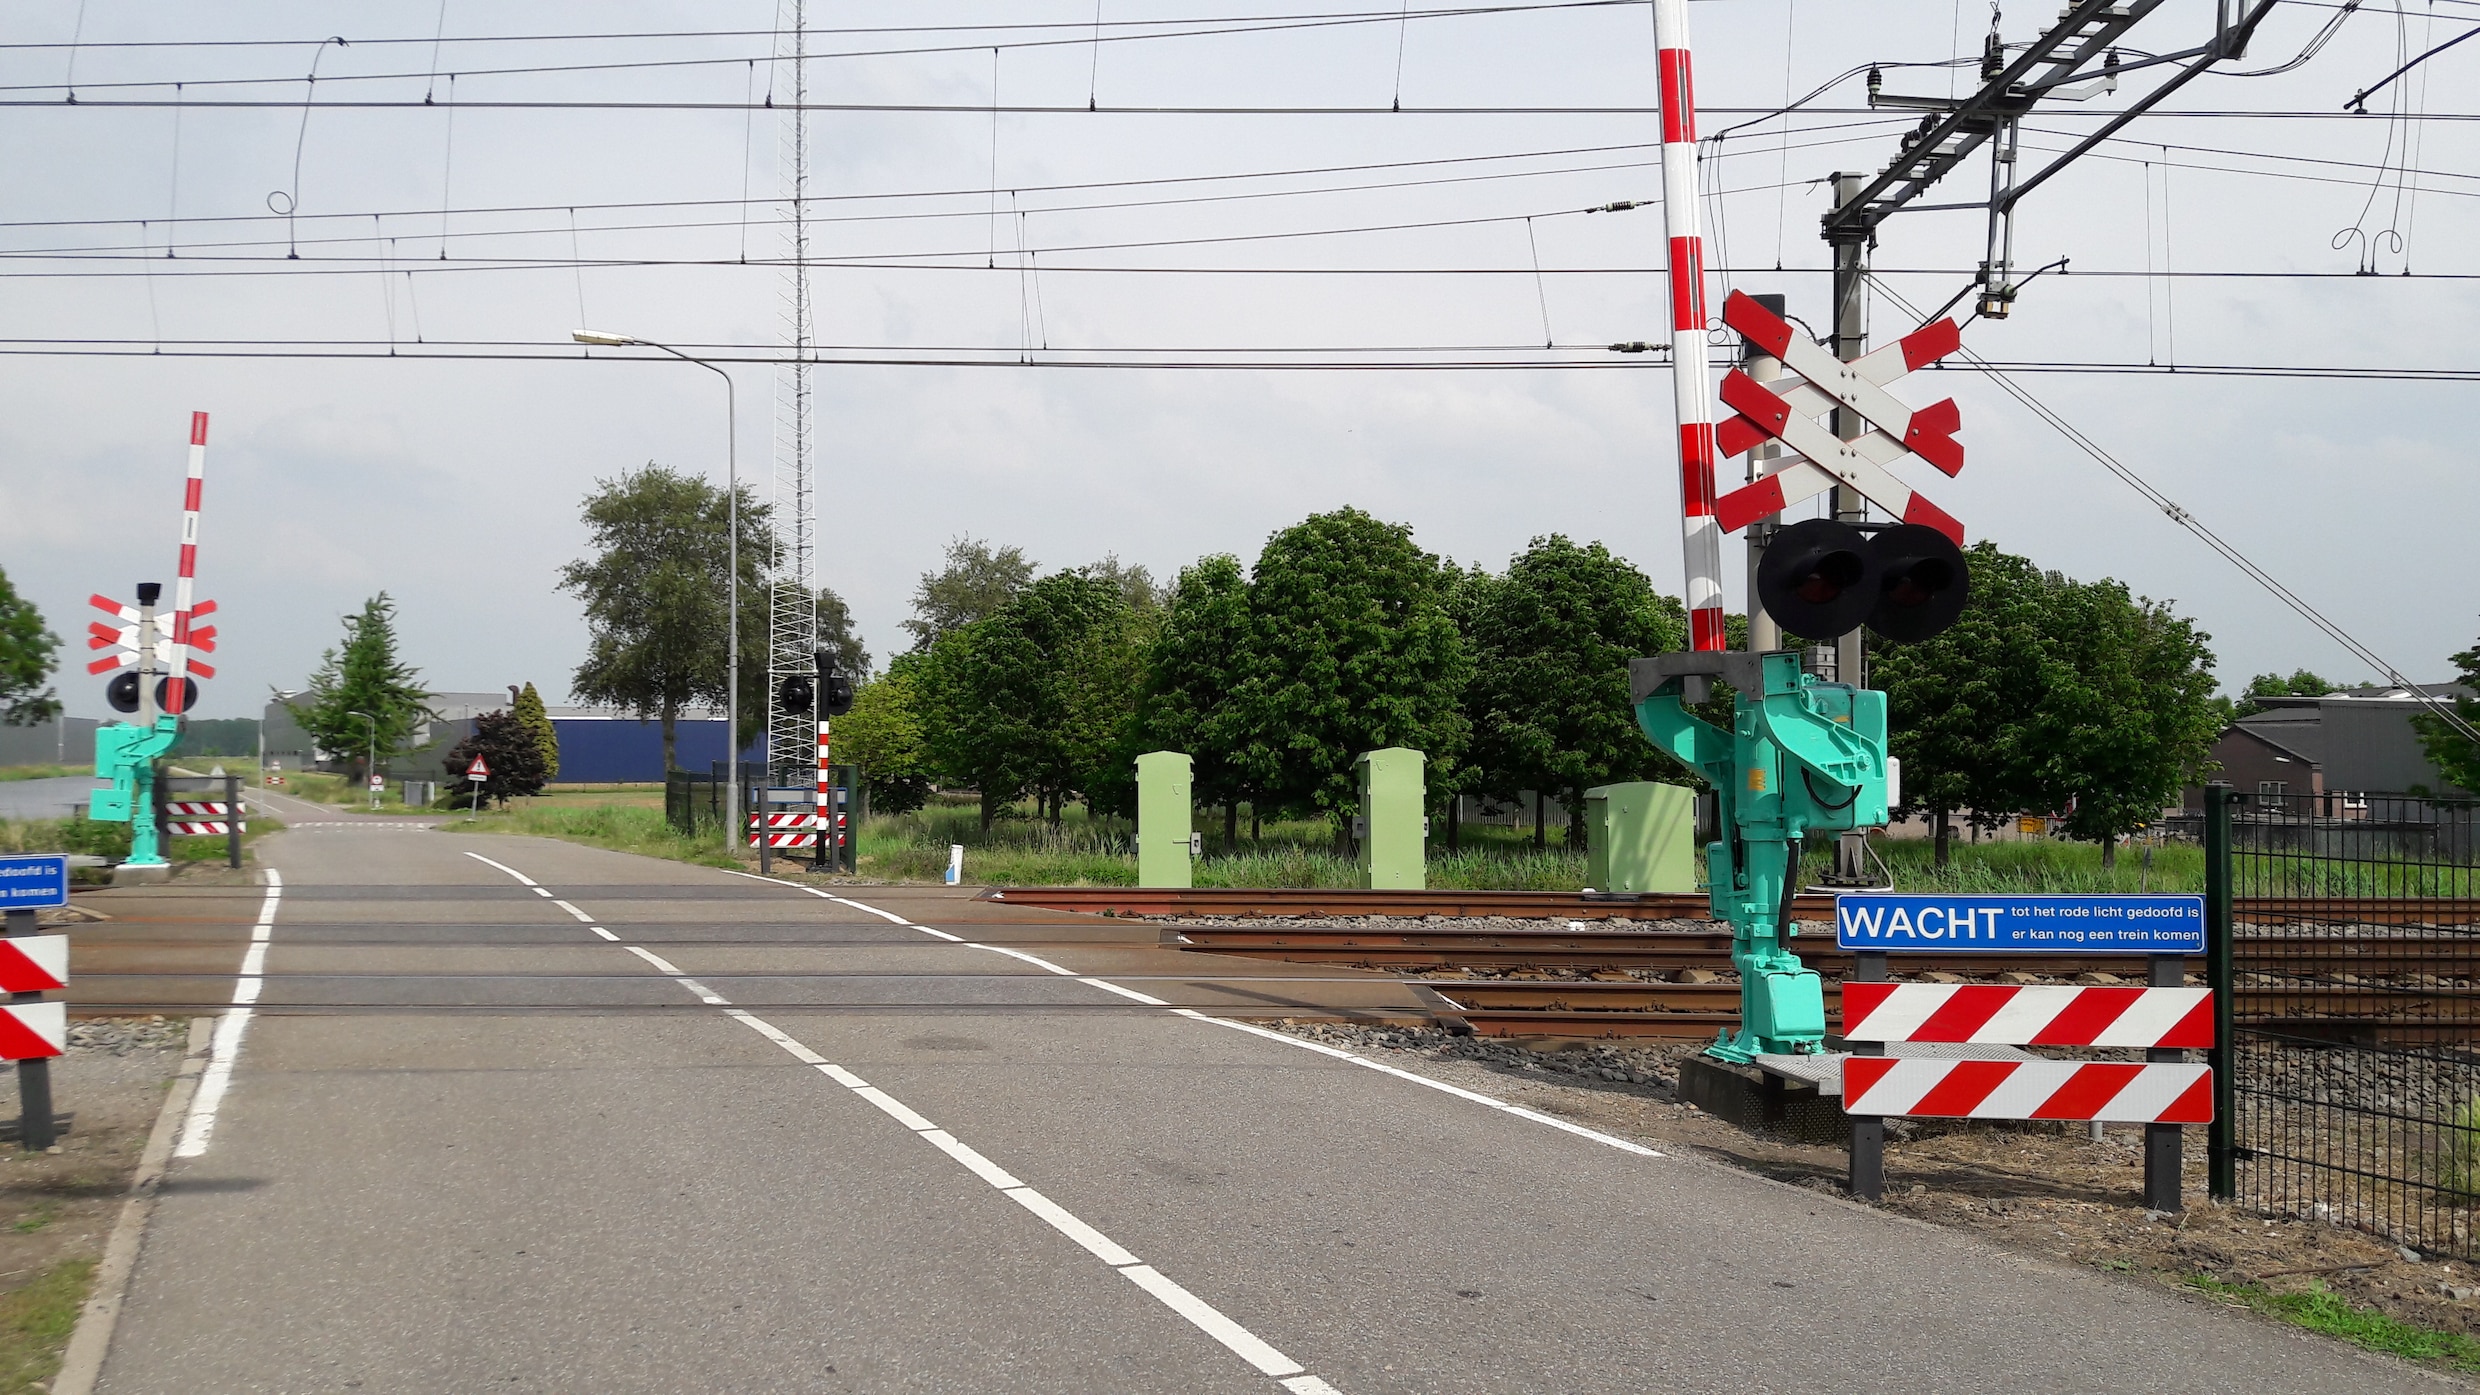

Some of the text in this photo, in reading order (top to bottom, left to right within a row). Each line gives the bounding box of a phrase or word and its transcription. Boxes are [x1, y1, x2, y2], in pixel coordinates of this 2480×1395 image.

[45, 865, 58, 875] is
[11, 887, 58, 897] komen
[2011, 906, 2199, 920] tot het rode licht gedoofd is
[1840, 906, 2005, 939] WACHT
[2012, 928, 2200, 943] er kan nog een trein komen
